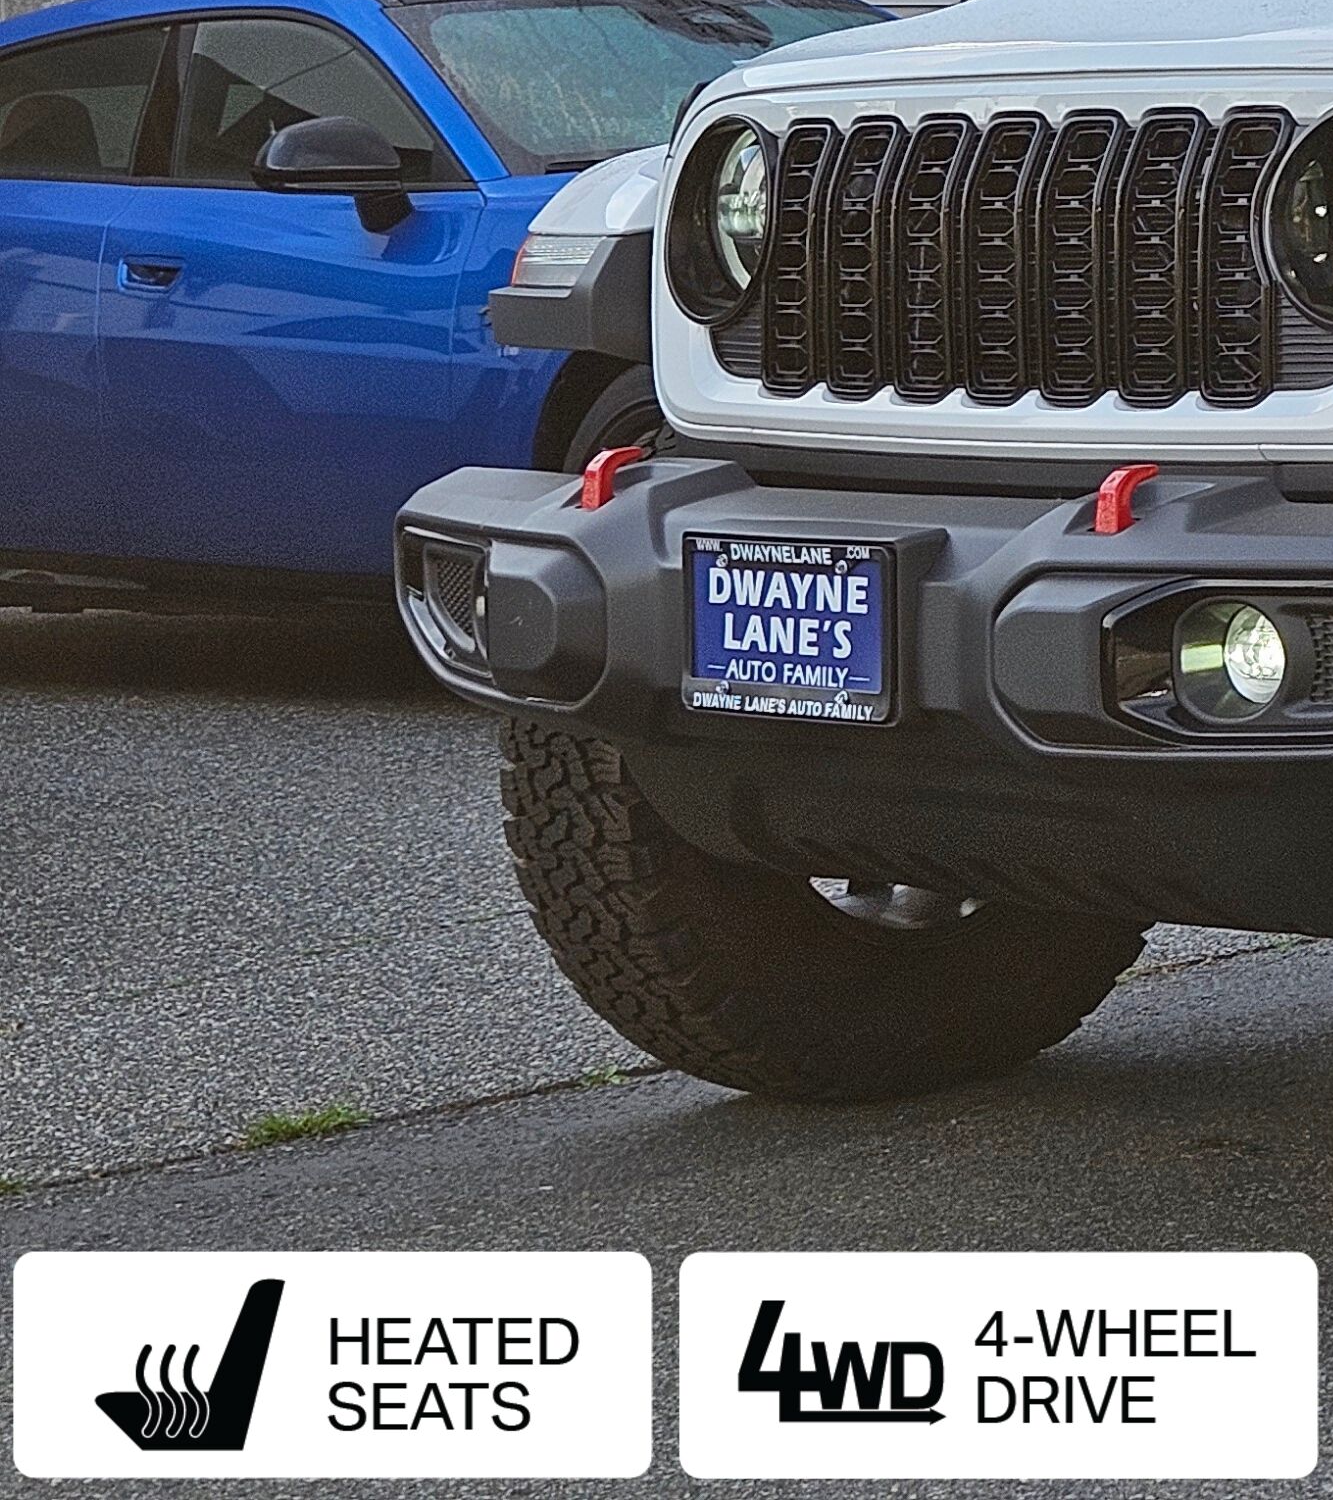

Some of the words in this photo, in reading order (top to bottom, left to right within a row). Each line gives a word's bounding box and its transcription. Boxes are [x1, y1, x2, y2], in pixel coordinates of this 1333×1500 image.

[730, 542, 833, 566] DWAYNELANE
[708, 565, 870, 615] DWAYNE
[722, 611, 852, 660] LANE'S
[725, 658, 777, 683] AUTO
[782, 663, 850, 690] FAMILY
[692, 690, 742, 711] DWAYNE
[743, 694, 786, 715] LANE'S
[787, 698, 823, 717] AUTO
[824, 700, 875, 722] FAMILY
